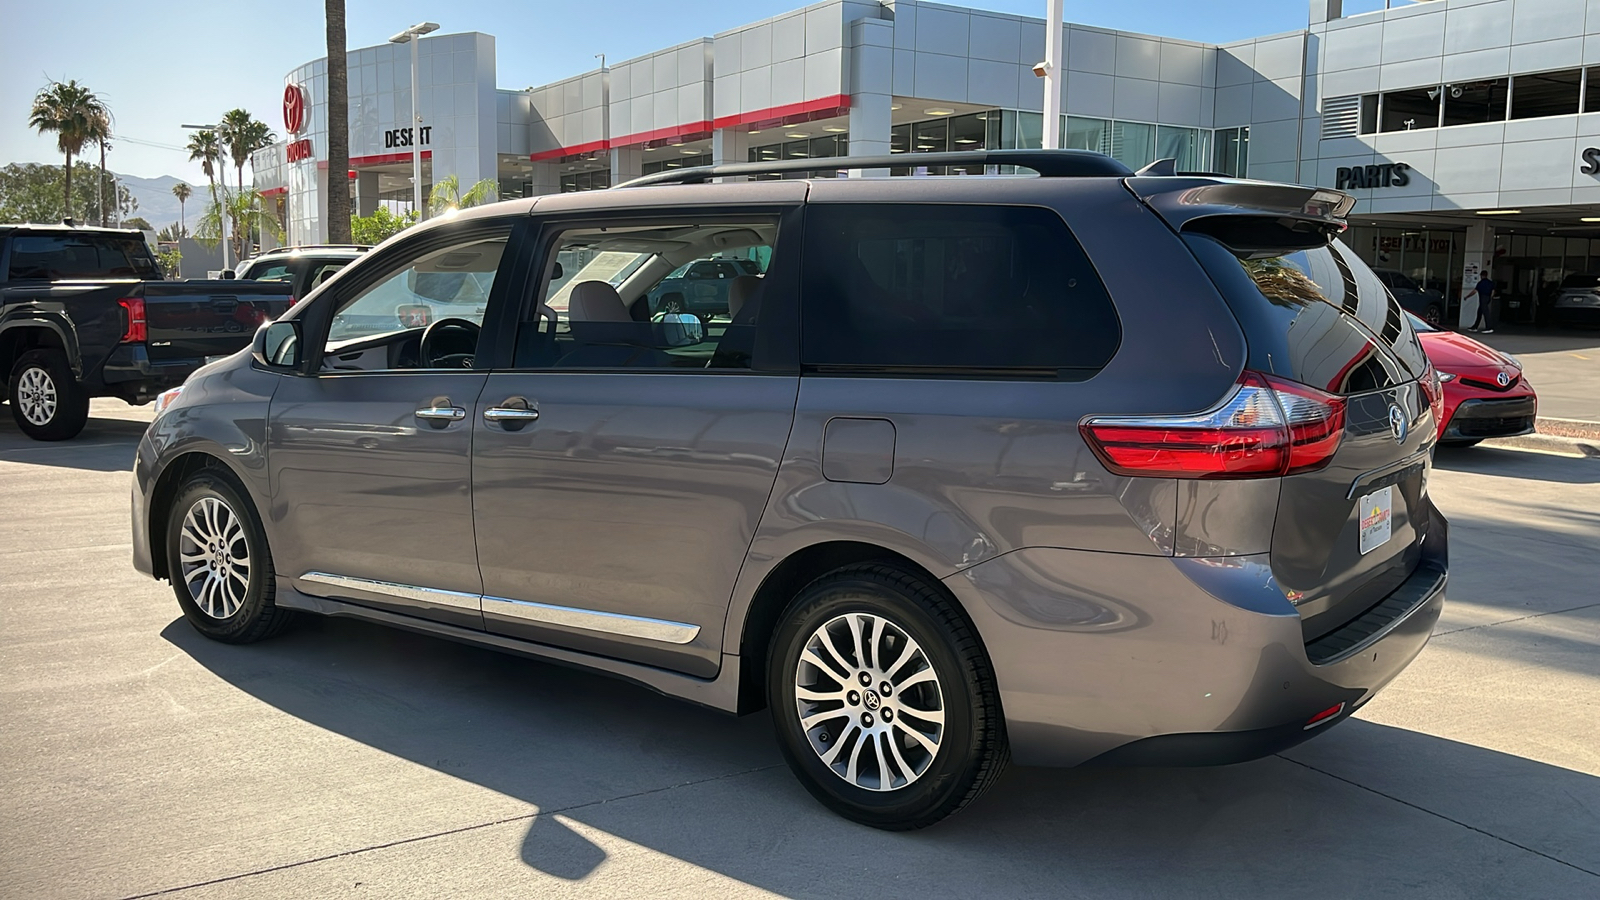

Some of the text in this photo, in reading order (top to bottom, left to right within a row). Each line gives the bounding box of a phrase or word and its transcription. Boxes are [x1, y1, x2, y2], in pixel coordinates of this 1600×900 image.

[385, 126, 432, 148] DESERT
[286, 139, 312, 163] TOYOTA
[1336, 162, 1410, 189] PARTS
